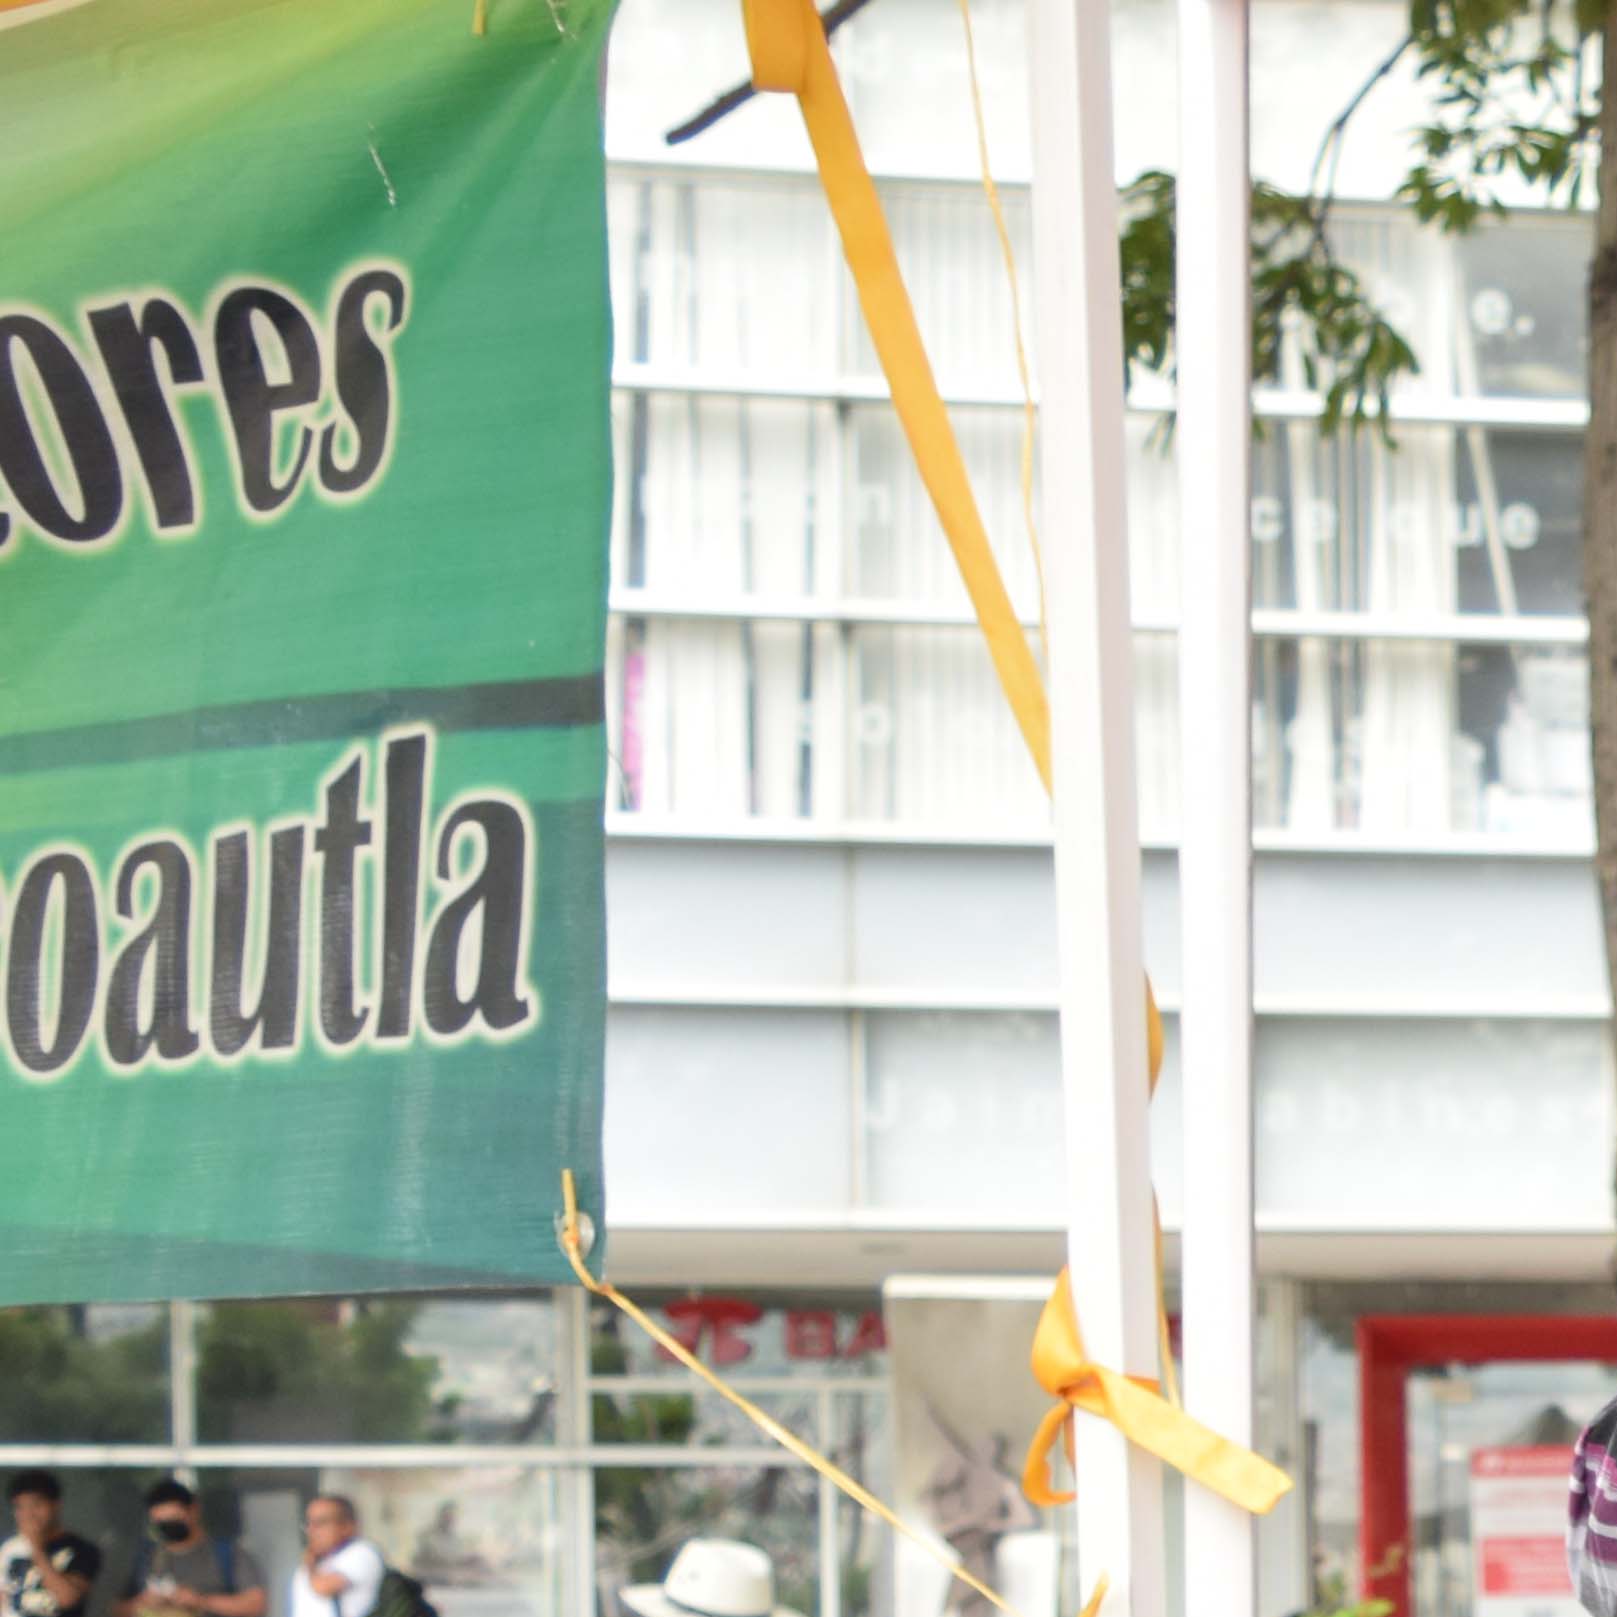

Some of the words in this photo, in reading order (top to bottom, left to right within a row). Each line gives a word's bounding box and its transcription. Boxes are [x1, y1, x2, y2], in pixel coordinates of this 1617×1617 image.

[0, 269, 408, 546] ores
[4, 730, 532, 1074] oautla
[1262, 1079, 1572, 1133] abines
